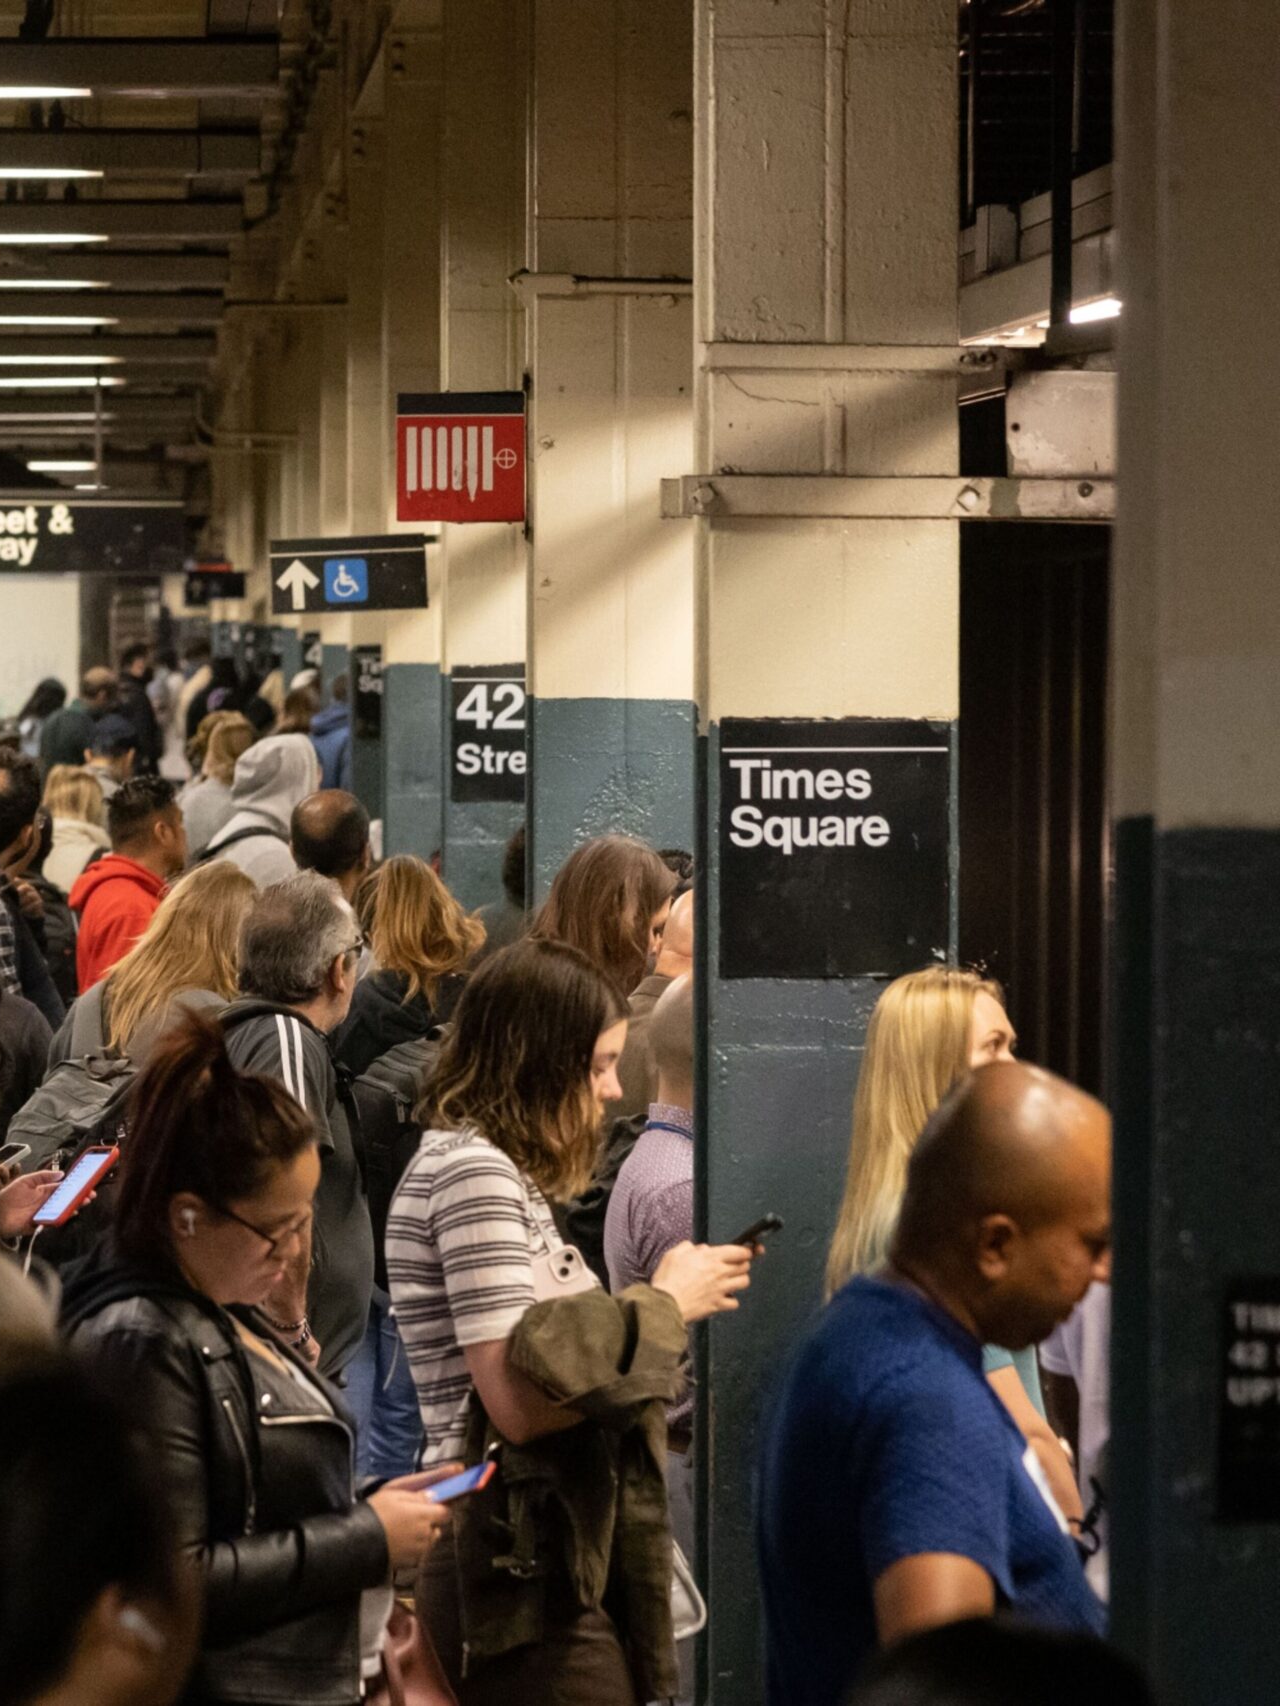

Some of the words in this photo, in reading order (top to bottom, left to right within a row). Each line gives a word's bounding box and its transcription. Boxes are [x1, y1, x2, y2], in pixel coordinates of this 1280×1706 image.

[48, 504, 74, 535] &
[456, 683, 525, 730] 42
[456, 742, 527, 775] Stre
[729, 759, 872, 800] Times
[729, 805, 890, 855] Square
